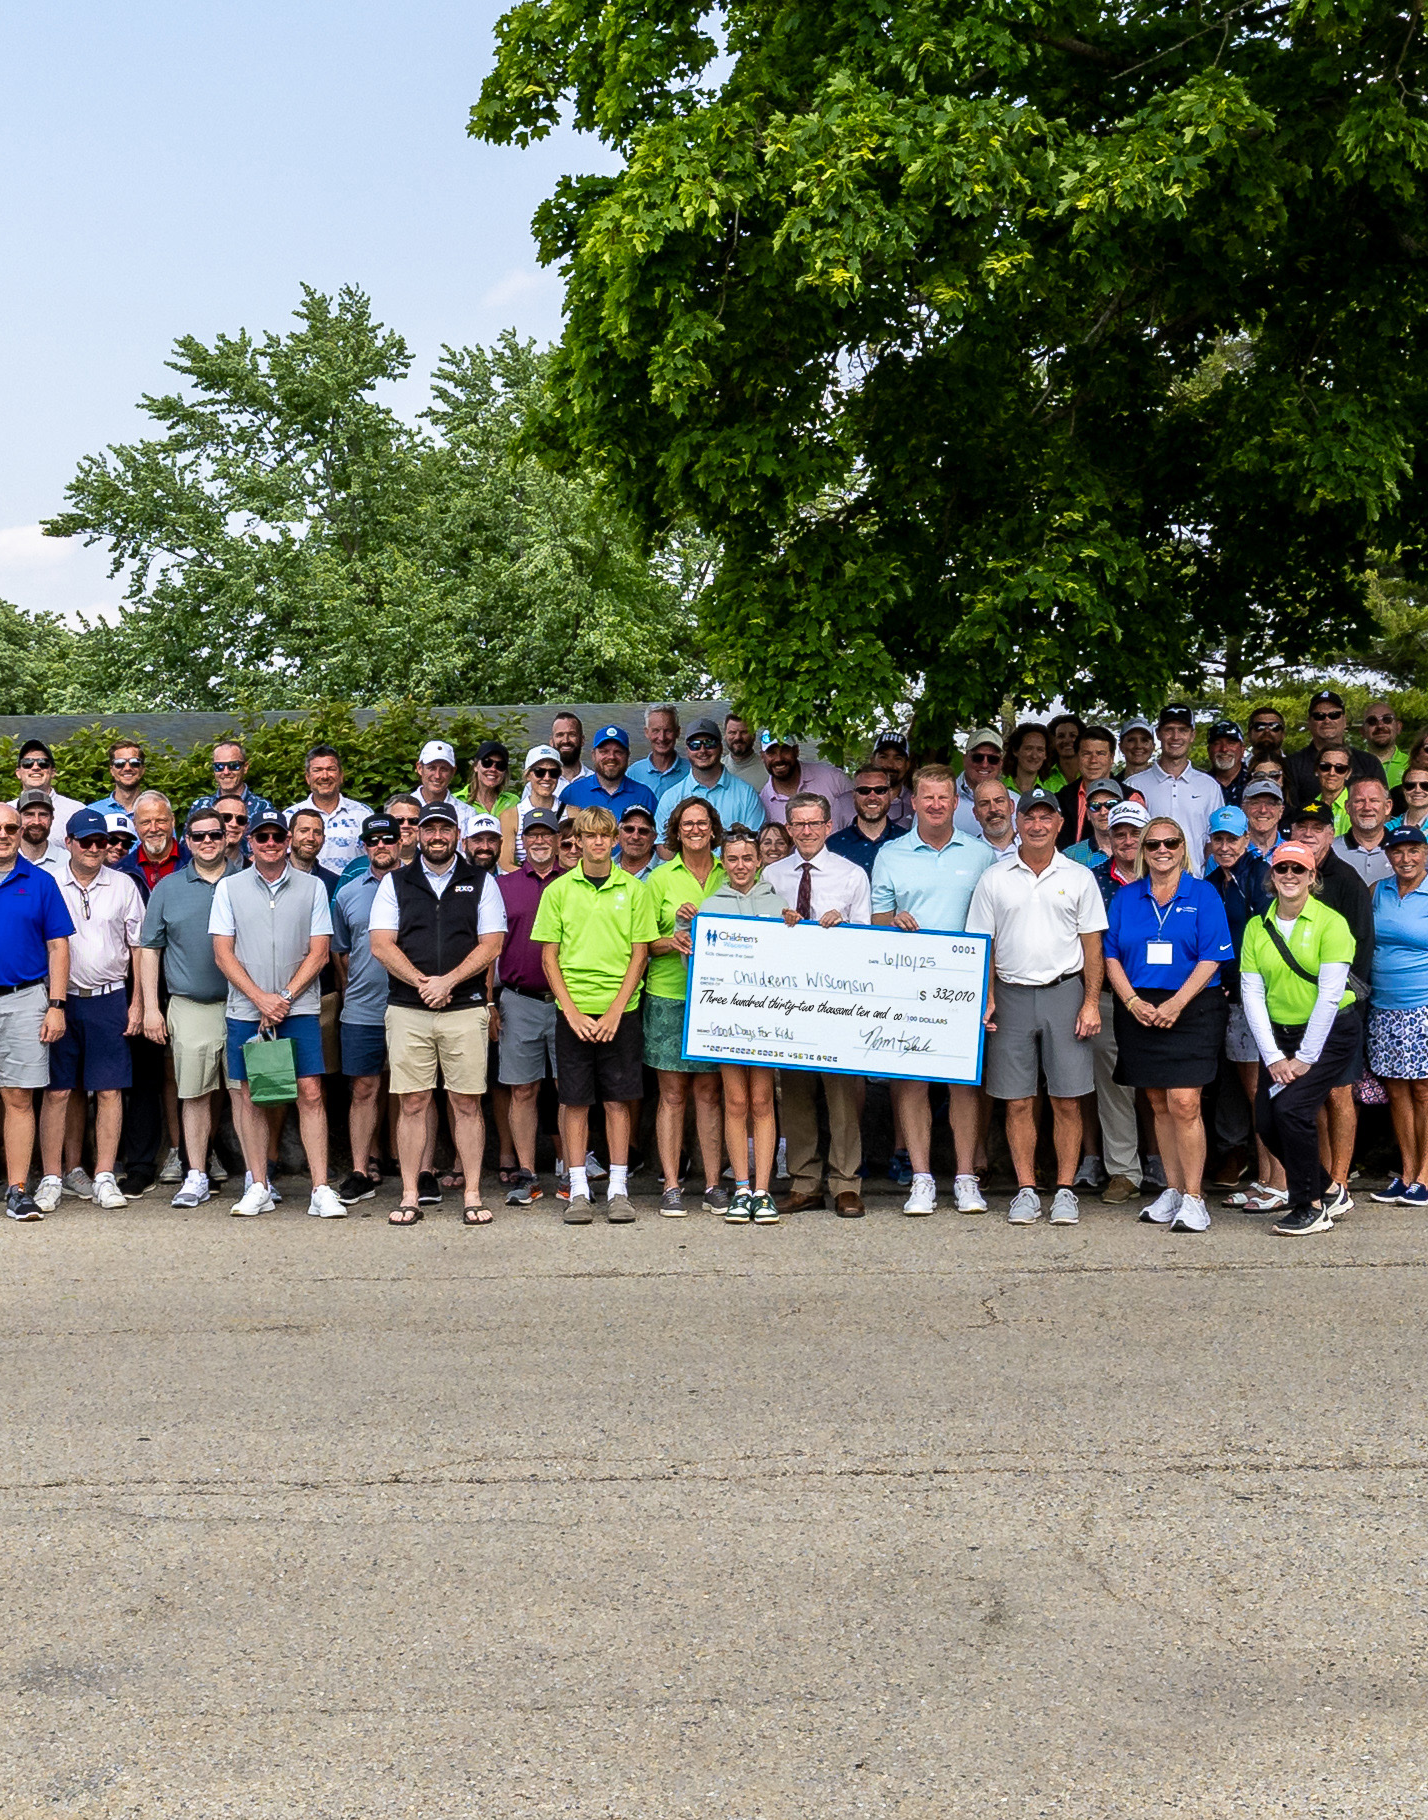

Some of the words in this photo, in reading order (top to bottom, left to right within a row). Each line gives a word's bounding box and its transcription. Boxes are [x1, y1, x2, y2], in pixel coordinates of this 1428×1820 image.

[718, 931, 758, 943] Children's
[951, 944, 976, 954] 0001
[884, 952, 936, 972] 6/10/25
[933, 987, 976, 1003] 332,010
[700, 990, 728, 1004] Three
[730, 992, 768, 1008] hundred
[768, 995, 815, 1016] thirty-two
[817, 1000, 857, 1016] thousand
[856, 1004, 871, 1018] ten
[873, 1007, 891, 1019] and
[918, 1016, 948, 1025] DOLLARS
[710, 1021, 735, 1037] Good
[734, 1023, 756, 1042] Days
[757, 1026, 772, 1038] For
[774, 1026, 794, 1040] Kids
